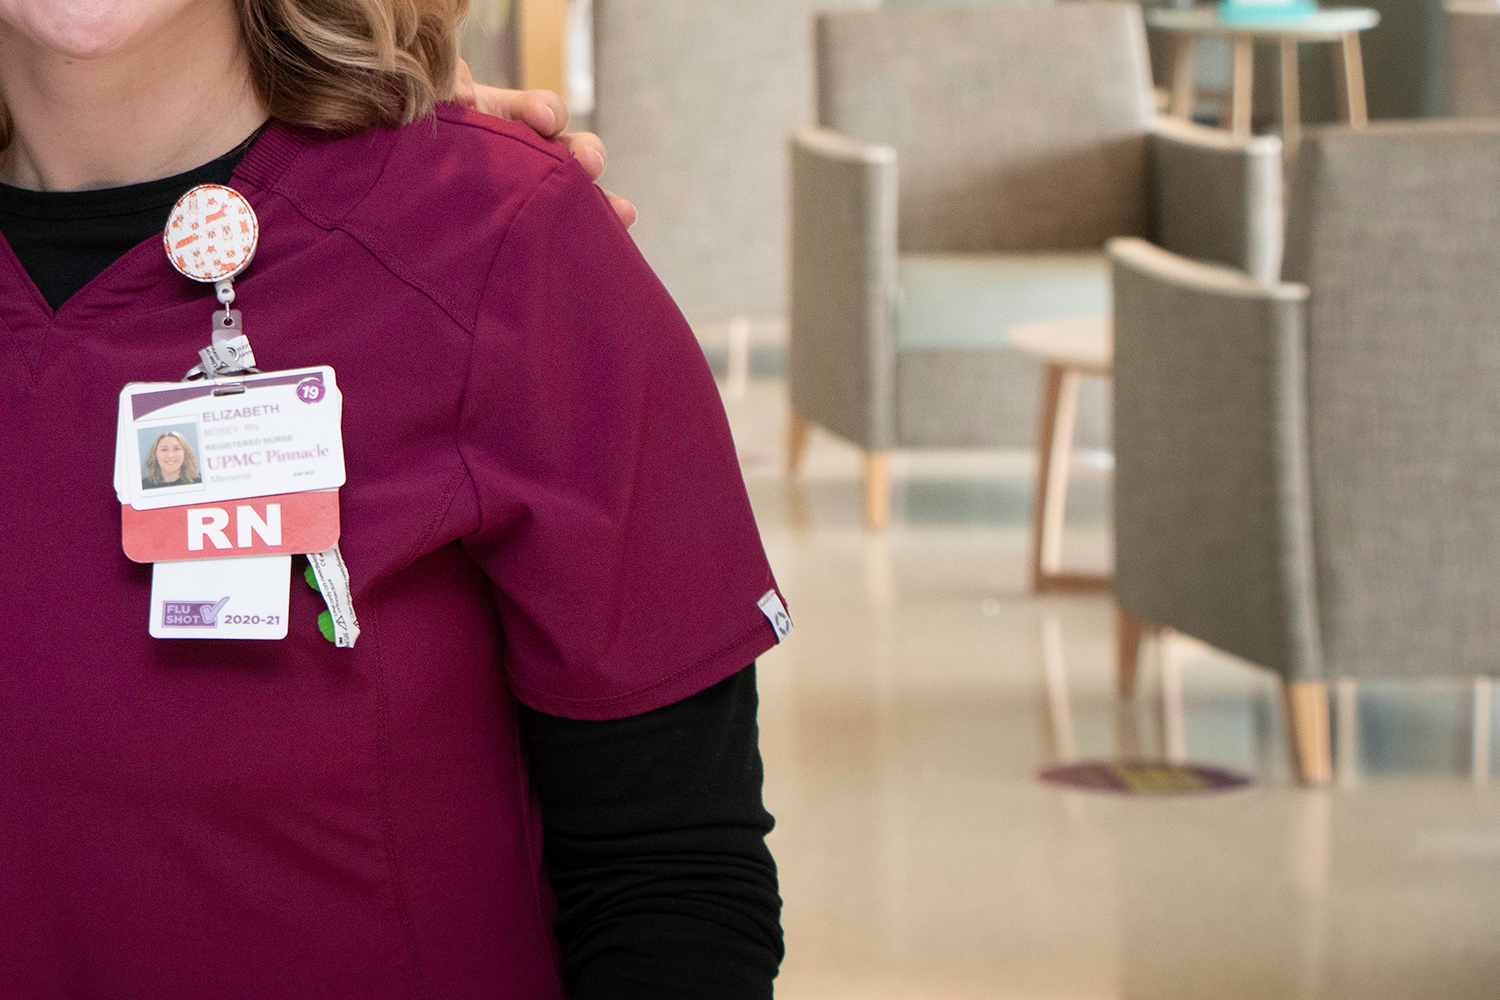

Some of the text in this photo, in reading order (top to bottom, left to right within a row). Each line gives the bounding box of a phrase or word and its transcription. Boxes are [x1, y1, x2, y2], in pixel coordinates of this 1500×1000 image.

[302, 385, 319, 399] 19
[202, 404, 280, 422] ELIZABETH
[244, 423, 260, 432] RN
[205, 434, 293, 451] REGISTERED NURSE
[207, 444, 330, 470] UPMC Pinnacle
[210, 472, 252, 484] Memorial
[187, 503, 282, 551] RN
[167, 605, 190, 614] FLU
[166, 615, 200, 624] SHOT
[224, 615, 280, 625] 2020-21
